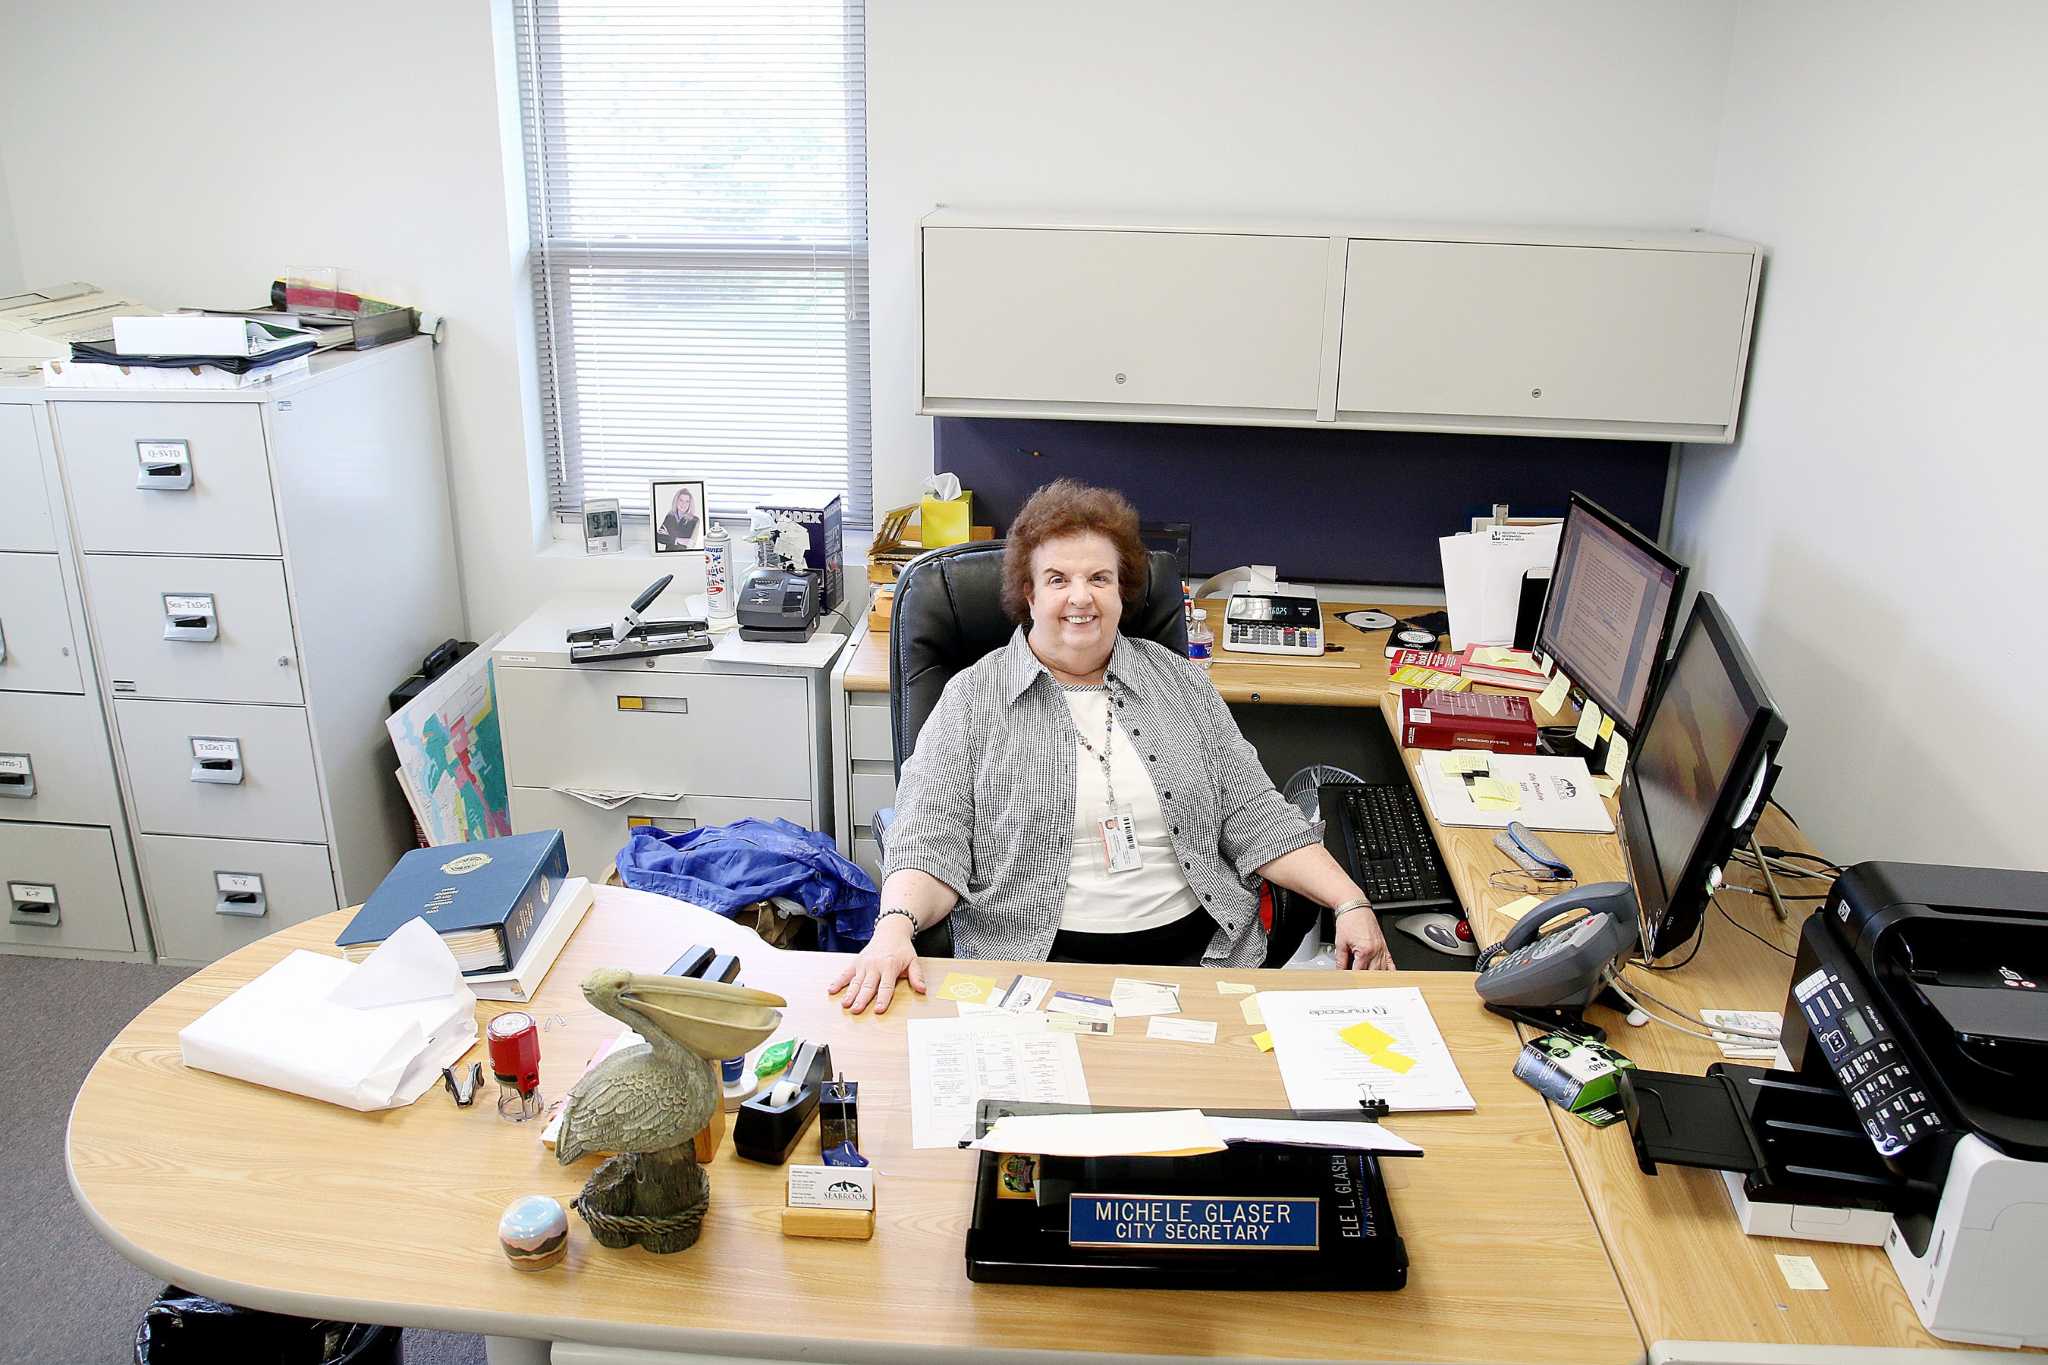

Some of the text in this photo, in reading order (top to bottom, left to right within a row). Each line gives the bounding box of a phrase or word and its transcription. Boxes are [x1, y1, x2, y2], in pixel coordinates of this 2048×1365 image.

[766, 510, 823, 523] OLODEX
[1095, 1202, 1291, 1224] MICHELE GLASER
[1116, 1223, 1270, 1241] CITY SECRETARY
